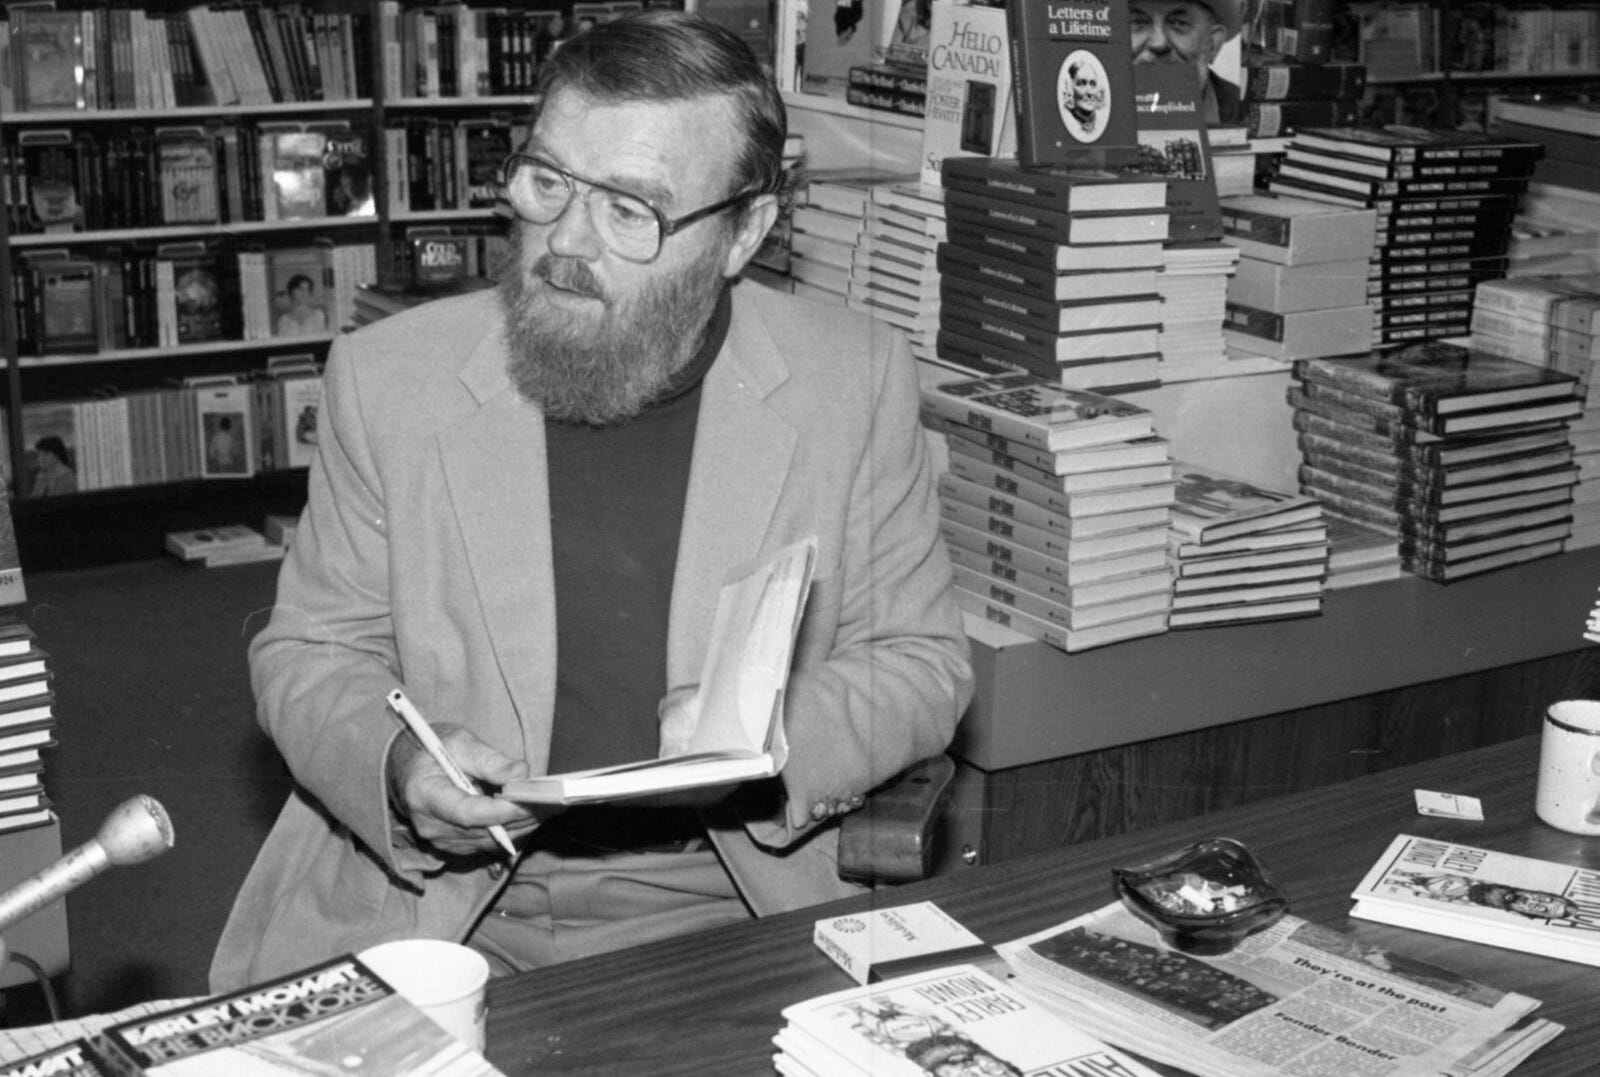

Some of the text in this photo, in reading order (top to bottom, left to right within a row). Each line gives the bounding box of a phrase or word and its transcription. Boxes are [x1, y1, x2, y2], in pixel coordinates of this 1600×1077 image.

[1048, 5, 1110, 21] Letters of
[1049, 21, 1111, 36] a Lifetime
[948, 22, 1001, 54] HELLO
[1293, 957, 1447, 1014] They're at the post
[120, 961, 361, 1046] FARLEY MOWAT
[944, 993, 1026, 1024] FARLEY
[1274, 1012, 1398, 1060] Fender Bender
